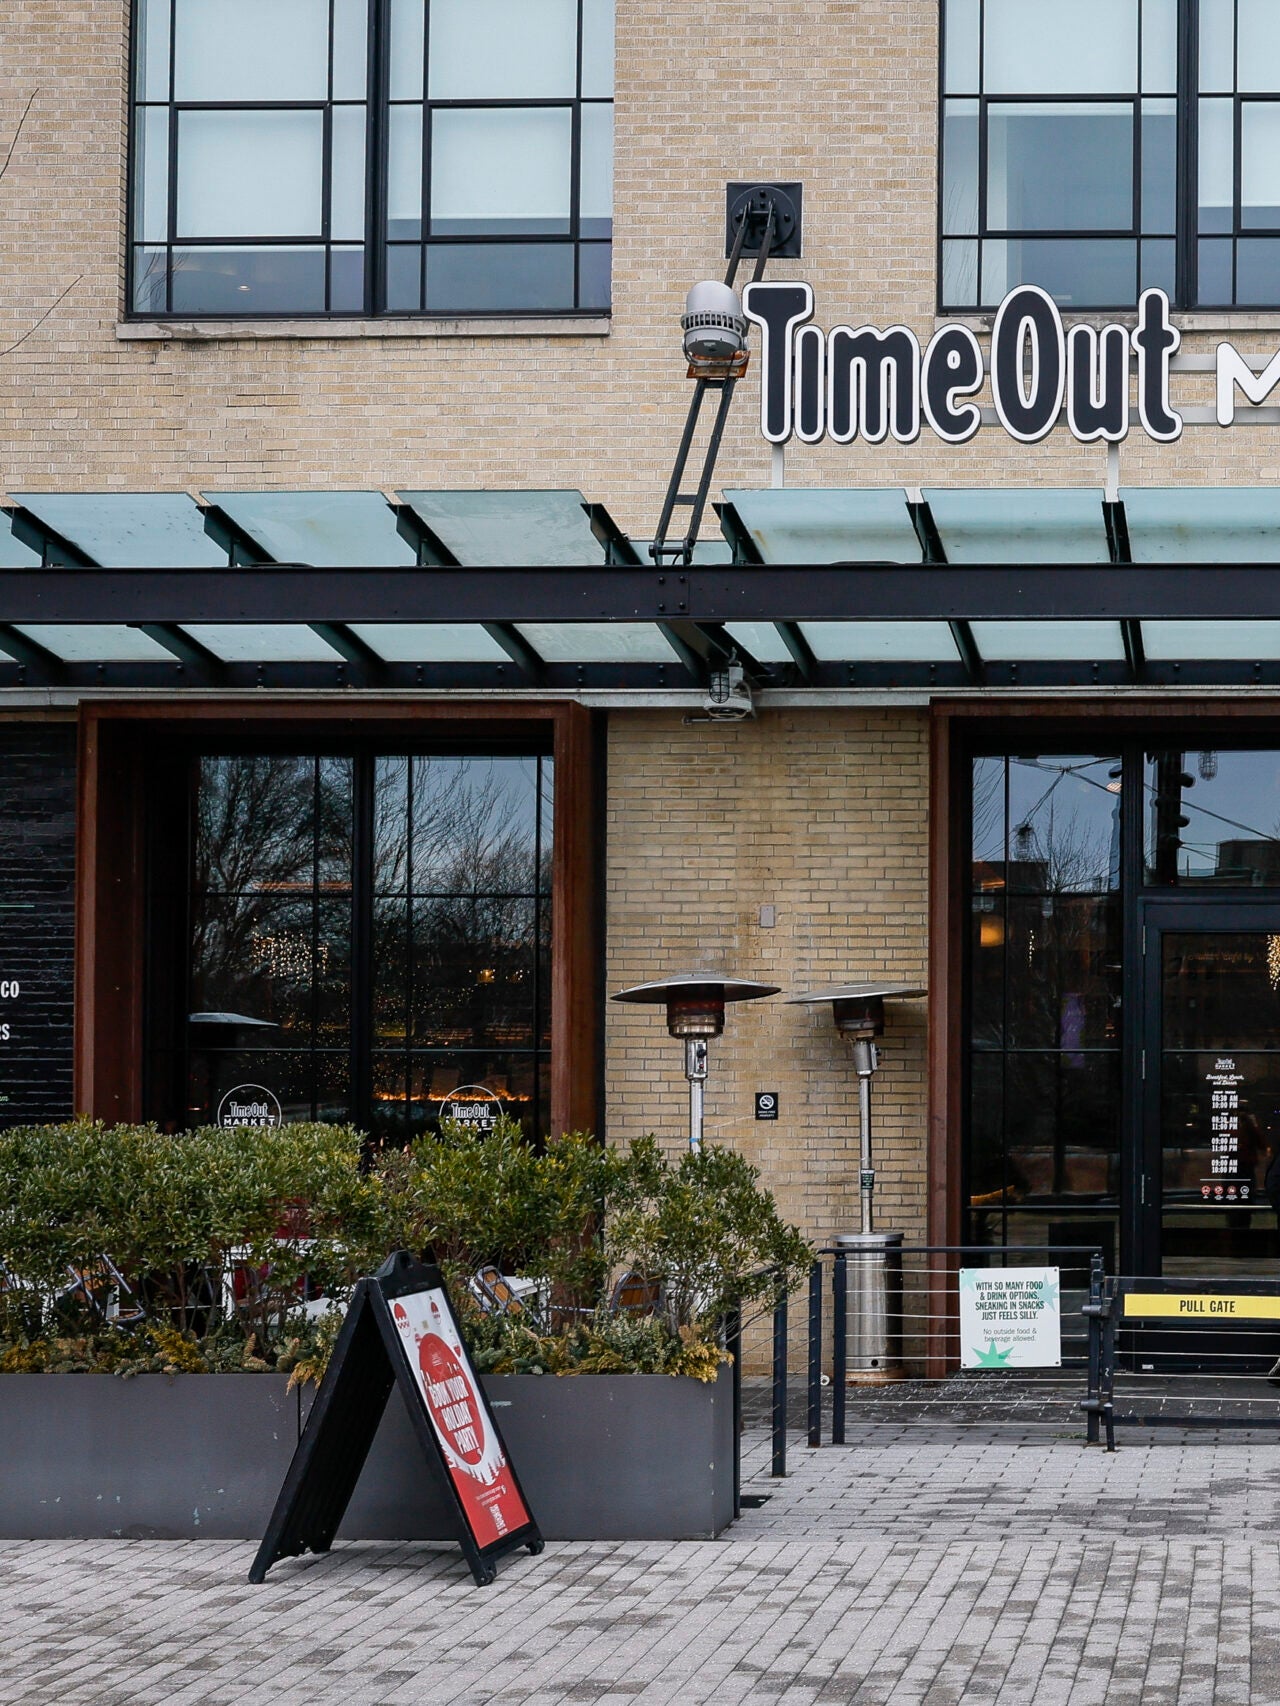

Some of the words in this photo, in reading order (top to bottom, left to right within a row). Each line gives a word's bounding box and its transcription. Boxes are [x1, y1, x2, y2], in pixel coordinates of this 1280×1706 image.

[975, 1282, 992, 1290] WITH
[994, 1281, 1003, 1290] SO
[1005, 1281, 1024, 1290] MANY
[1026, 1281, 1043, 1289] FOOD
[980, 1292, 985, 1300] &
[987, 1292, 1007, 1300] DRINK
[975, 1301, 1007, 1310] SNEAKING
[1010, 1301, 1016, 1309] IN
[1018, 1301, 1044, 1309] SNACKS
[1180, 1300, 1205, 1312] PULL
[1209, 1300, 1235, 1313] GATE
[982, 1311, 996, 1320] JUST
[999, 1311, 1017, 1320] FEELS
[428, 1381, 452, 1408] BOOK
[445, 1375, 469, 1401] YOUR
[441, 1400, 473, 1431] HOLIDAY
[454, 1425, 479, 1454] PARTY
